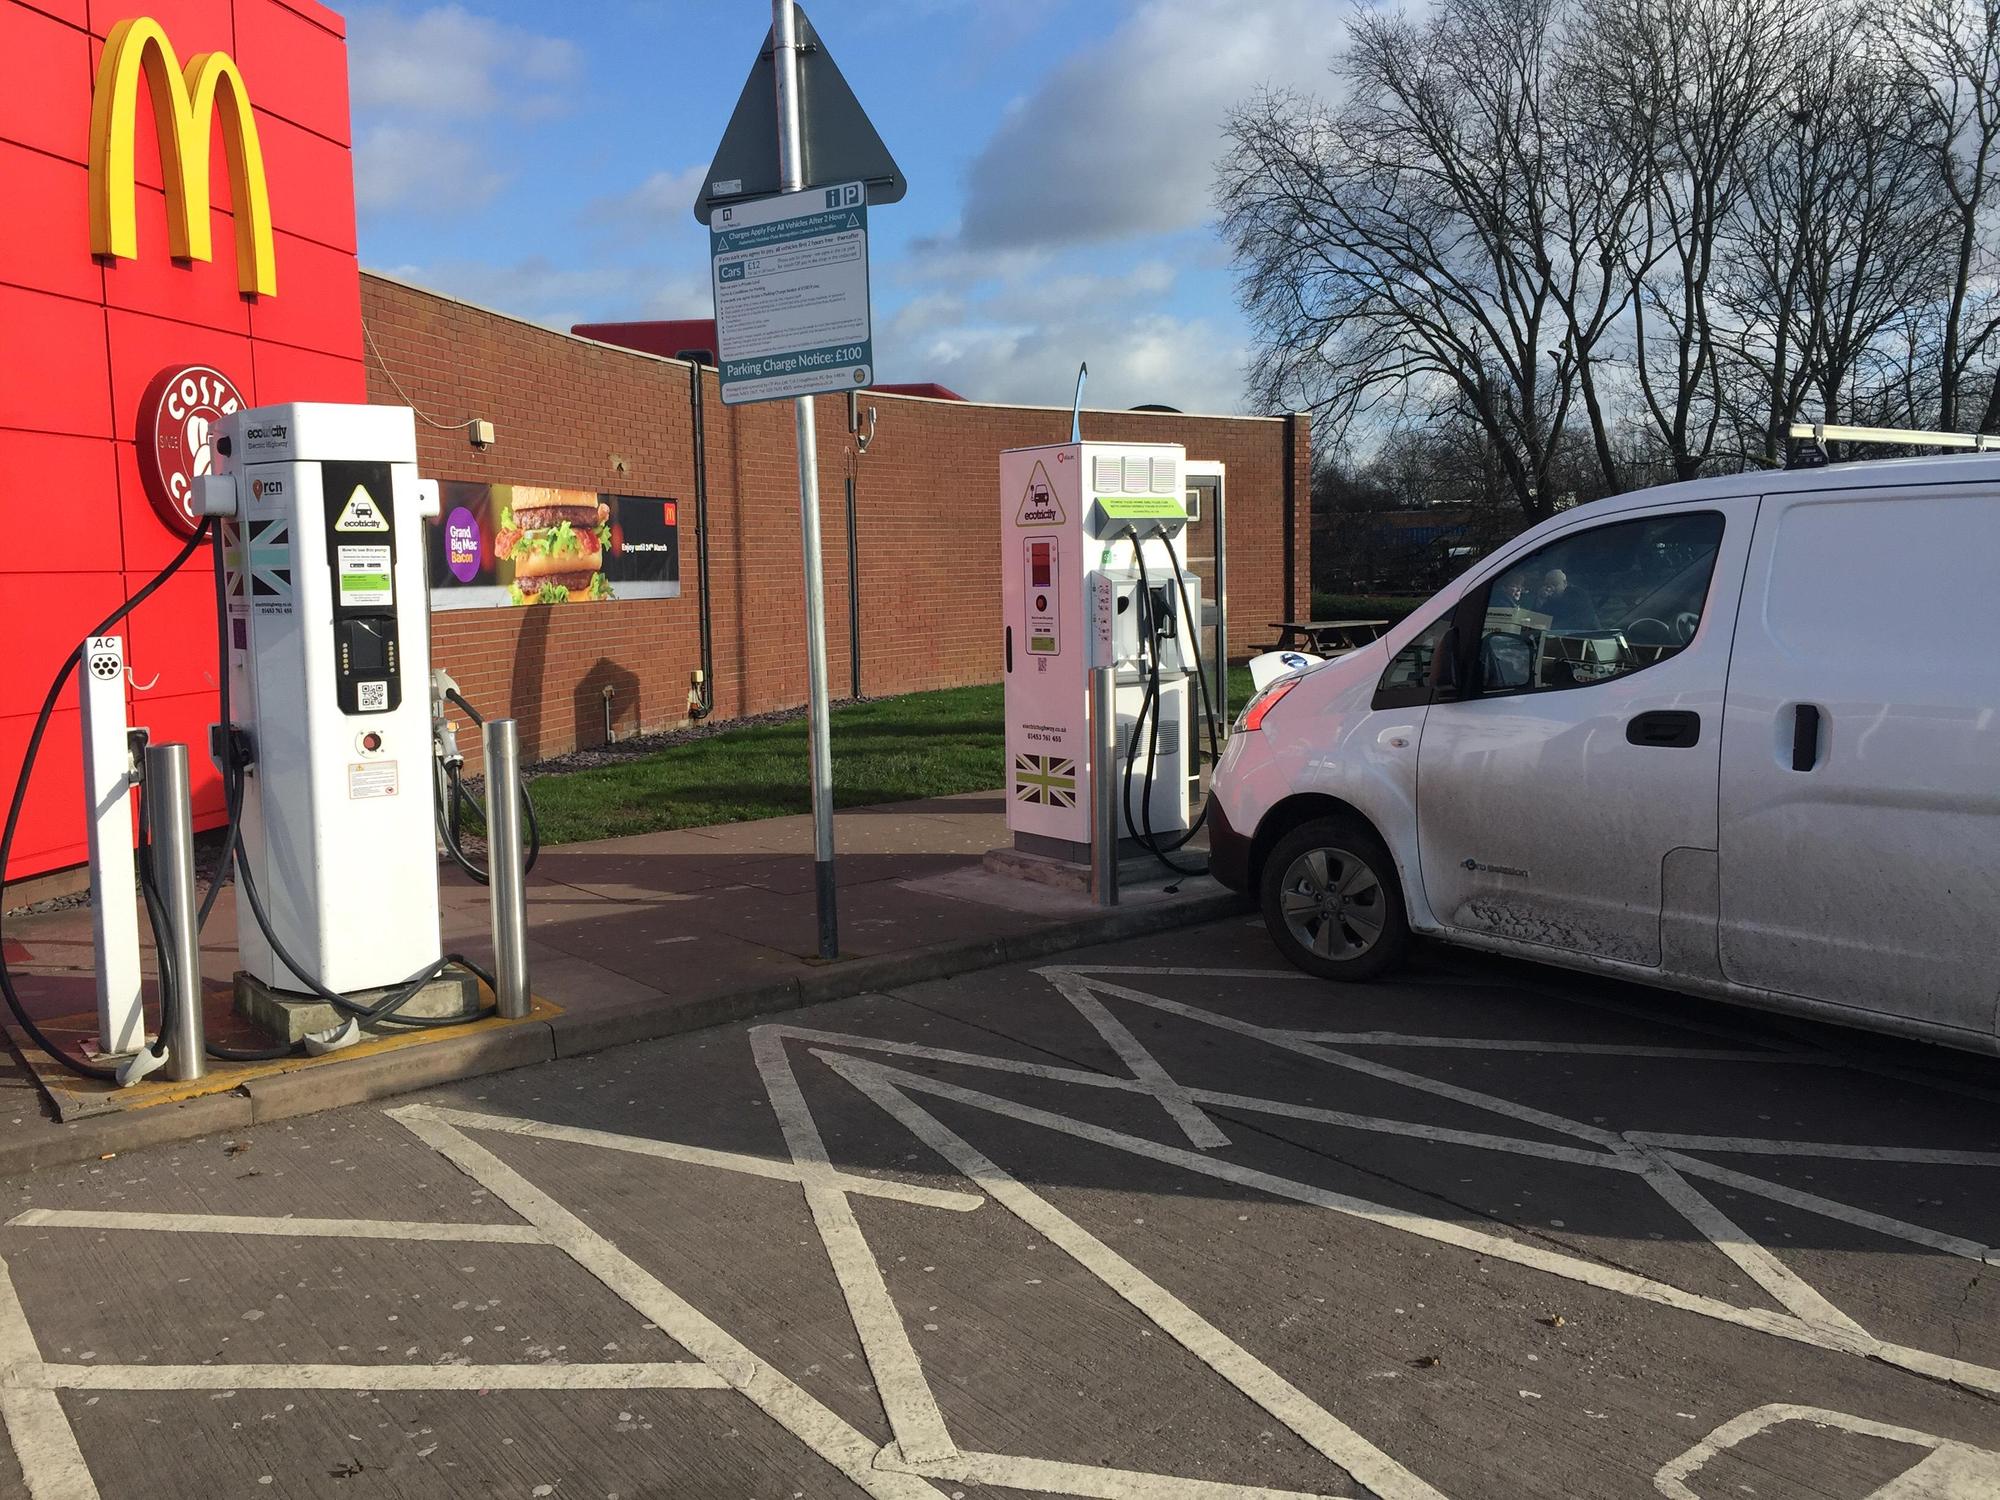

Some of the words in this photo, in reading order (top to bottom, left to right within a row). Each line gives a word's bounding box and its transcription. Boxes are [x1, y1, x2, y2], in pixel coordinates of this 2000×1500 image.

[728, 229, 750, 241] Charges
[750, 226, 766, 236] Apply
[766, 224, 776, 232] For
[784, 218, 807, 229] Vehicles
[808, 215, 823, 224] After
[828, 210, 846, 220] Hours
[721, 264, 741, 278] Cars
[747, 260, 760, 270] £12
[726, 360, 761, 378] Parking
[762, 355, 796, 374] Charge
[798, 350, 833, 366] Notice:
[835, 346, 862, 362] £100
[168, 376, 239, 421] COSTA
[264, 480, 282, 492] rcn
[1024, 508, 1056, 520] ecotricity
[344, 519, 380, 528] ecotricity
[450, 525, 472, 538] Grand
[451, 538, 463, 554] Big
[462, 538, 478, 551] Mac
[622, 542, 635, 553] Enjoy
[654, 543, 668, 552] March
[452, 552, 474, 564] Bacon
[93, 637, 115, 649] AC
